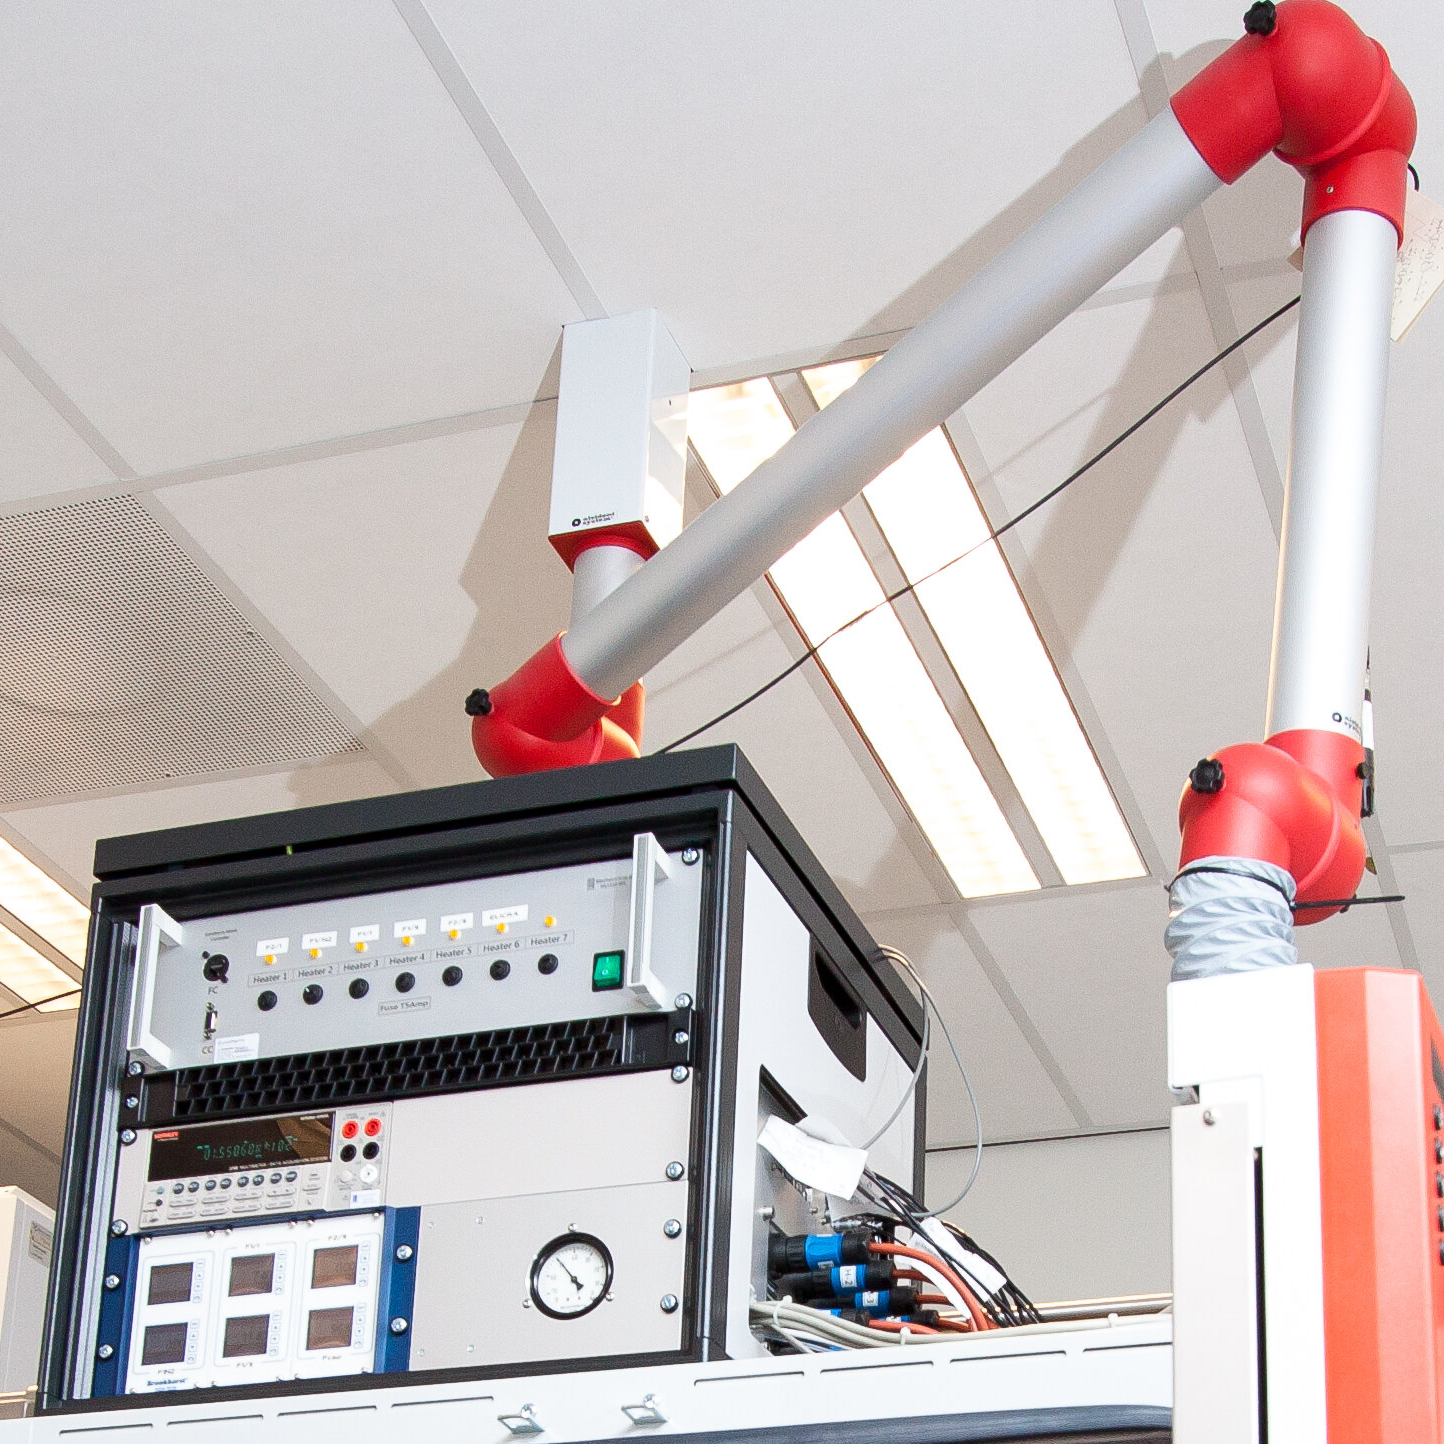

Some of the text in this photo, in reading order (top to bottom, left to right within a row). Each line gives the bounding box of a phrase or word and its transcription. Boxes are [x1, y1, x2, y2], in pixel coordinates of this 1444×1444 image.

[530, 933, 568, 946] Heater 7
[435, 946, 472, 959] Heater 5
[483, 940, 520, 953] Heater 6
[389, 952, 425, 965] Heater 4
[297, 966, 334, 978] Heater 2
[343, 959, 379, 972] Heater 3
[253, 972, 288, 985] Heater 1
[208, 986, 219, 995] FC
[380, 1003, 399, 1012] Fuse
[845, 1269, 853, 1285] H-2
